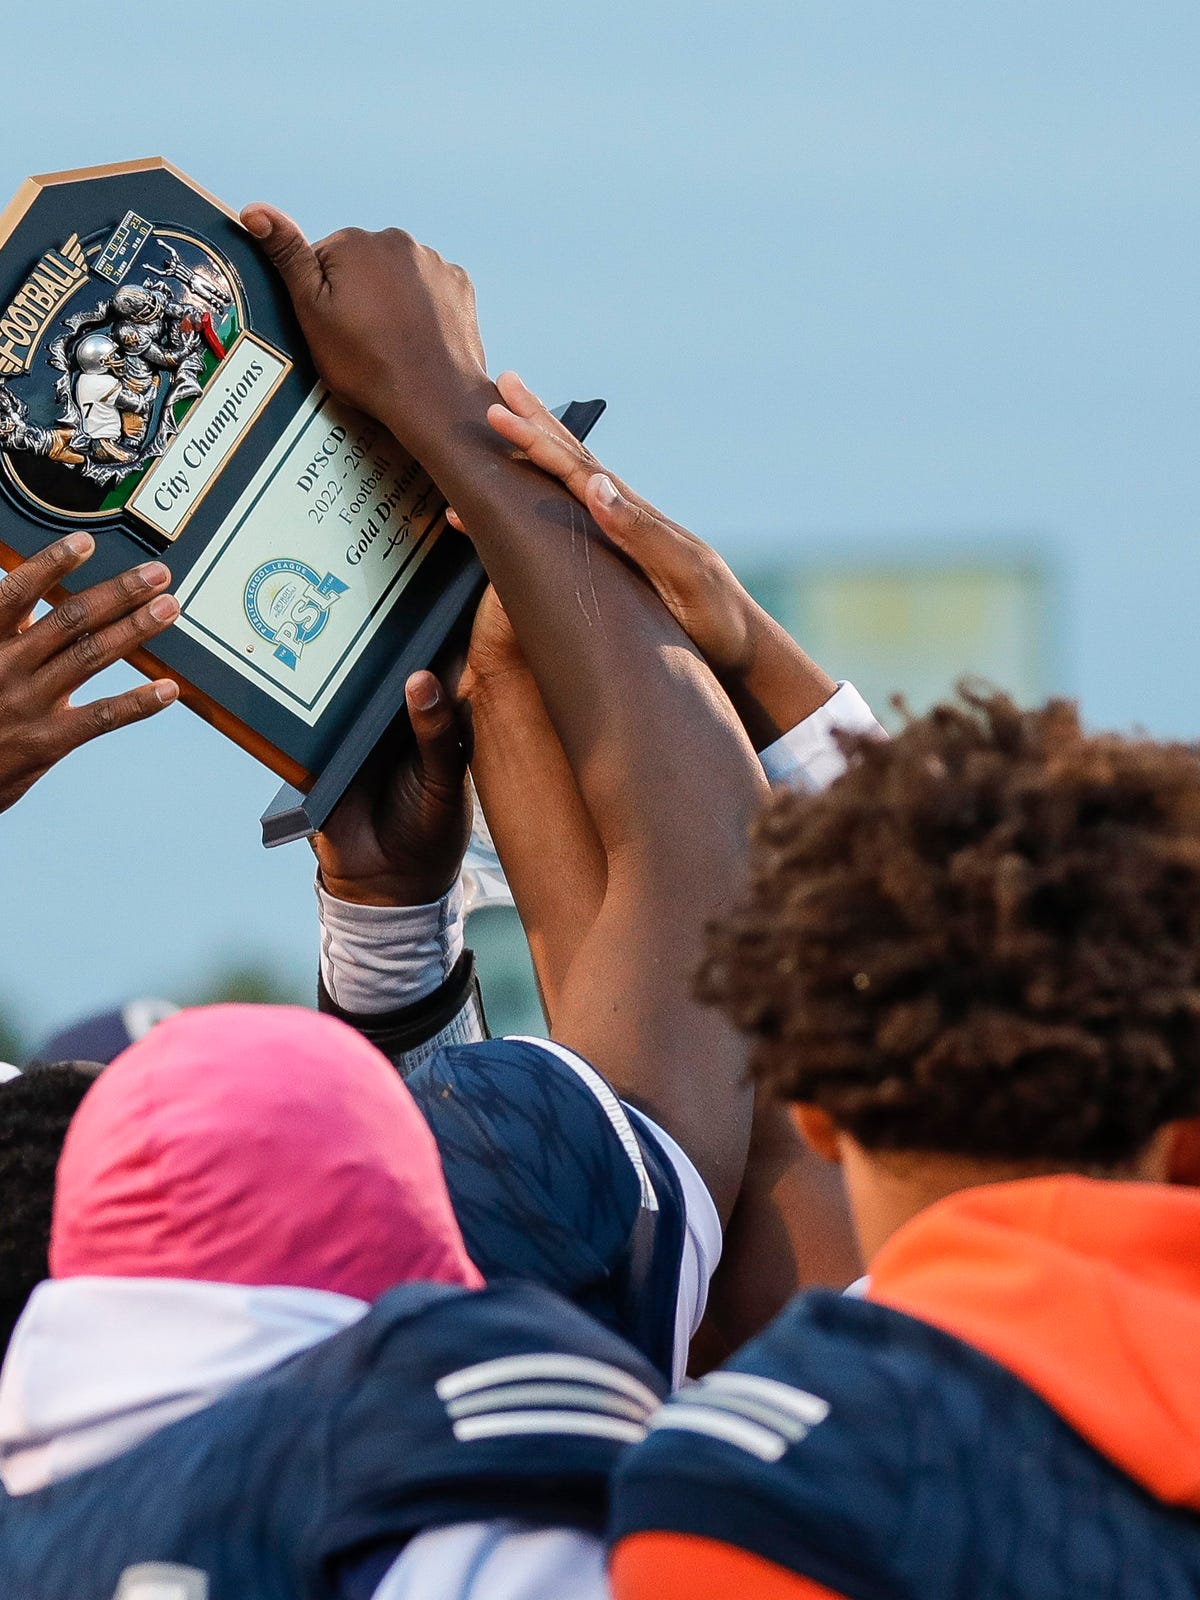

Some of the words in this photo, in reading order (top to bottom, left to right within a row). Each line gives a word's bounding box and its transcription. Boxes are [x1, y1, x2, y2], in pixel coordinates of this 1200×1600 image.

[83, 402, 94, 418] 7
[154, 470, 190, 511] City
[183, 360, 264, 469] Champions
[296, 426, 347, 493] DPSCD
[308, 480, 343, 524] 2022
[338, 456, 391, 525] Football
[345, 518, 381, 565] Gold
[375, 460, 423, 523] Divisio
[248, 568, 270, 598] SCHOOL
[272, 562, 307, 574] LEAGUE
[247, 604, 267, 634] PUBLIC
[274, 584, 341, 660] PSL
